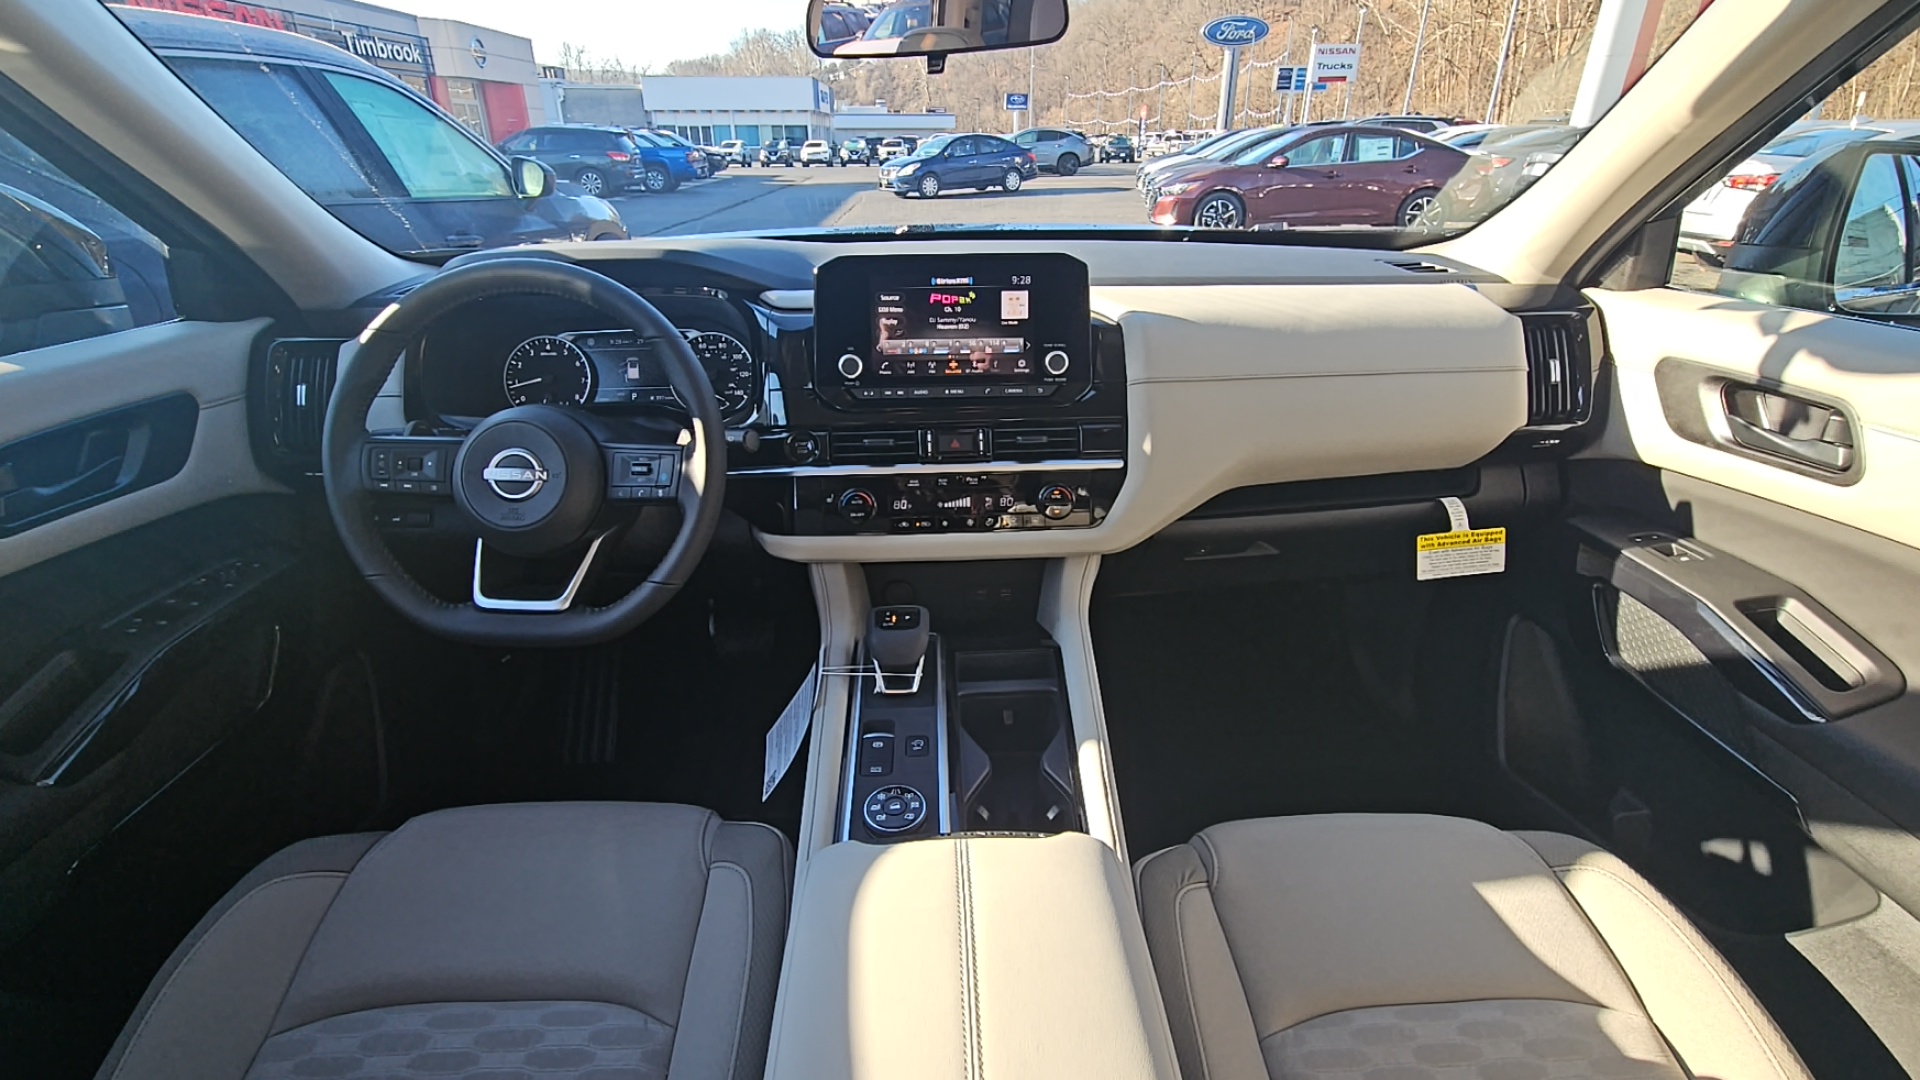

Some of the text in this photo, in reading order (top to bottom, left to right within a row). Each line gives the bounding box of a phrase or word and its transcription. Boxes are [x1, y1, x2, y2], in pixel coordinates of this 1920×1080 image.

[1216, 21, 1256, 41] Ford
[341, 30, 423, 64] Timbrook
[1317, 47, 1357, 55] NISSAN
[1317, 62, 1353, 70] Trucks
[1012, 275, 1031, 285] 9:28
[893, 499, 907, 510] 80
[1000, 497, 1014, 507] 80
[1471, 530, 1503, 538] Equipped
[1437, 539, 1471, 547] Advanced
[1484, 536, 1502, 544] Bags
